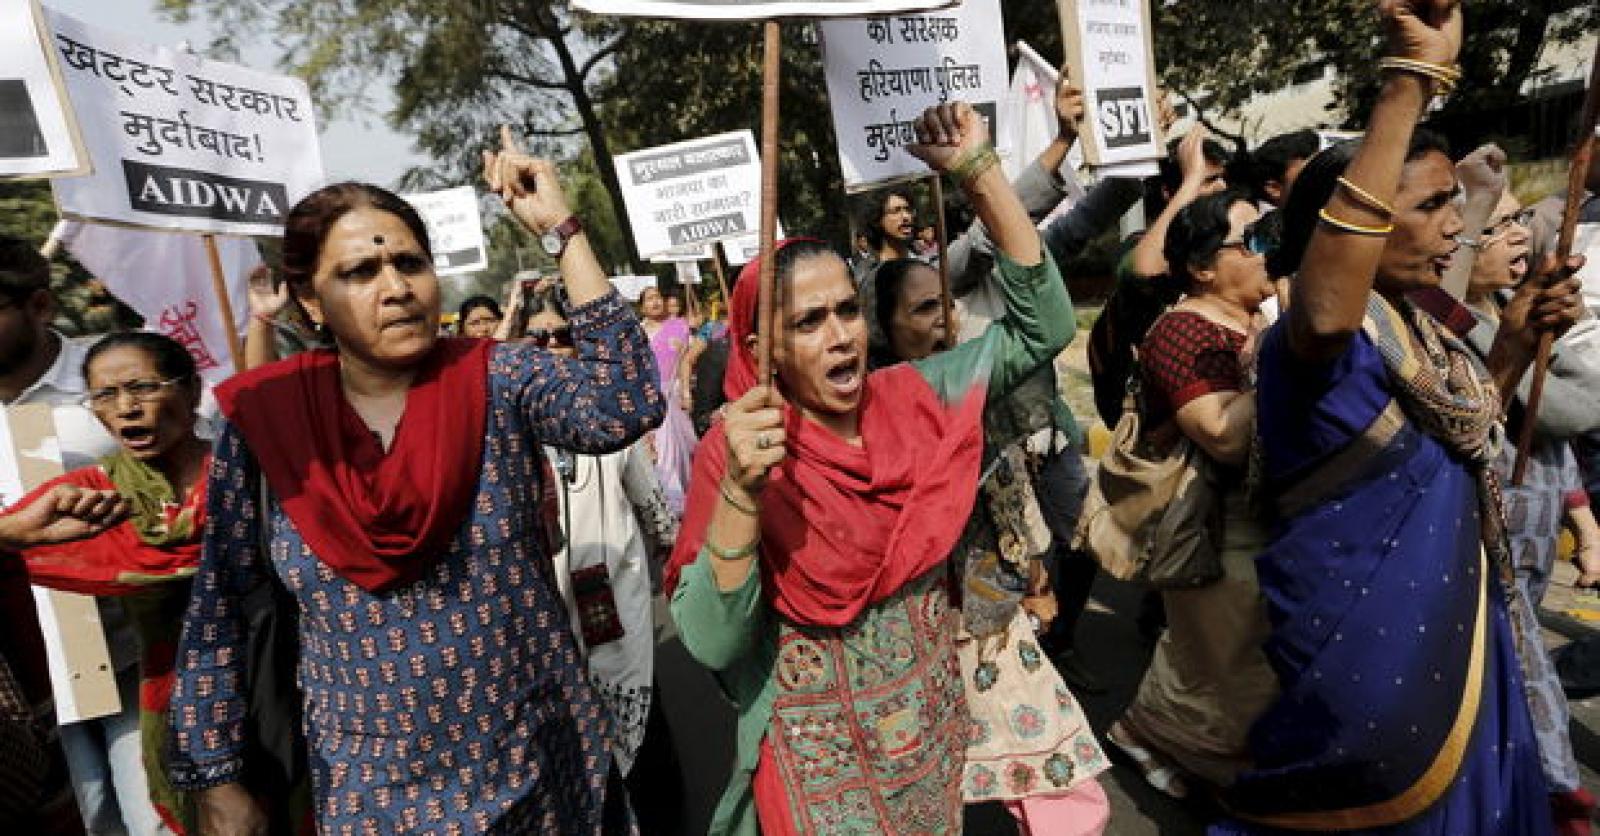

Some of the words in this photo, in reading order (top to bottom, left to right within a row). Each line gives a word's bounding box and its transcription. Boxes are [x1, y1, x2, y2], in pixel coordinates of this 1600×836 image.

[57, 34, 178, 96] खट्टर
[186, 75, 302, 121] सरकार
[858, 59, 932, 103] हरियाणा
[934, 56, 980, 103] पुलिस
[120, 110, 264, 162] मुर्दाबाद!
[140, 173, 280, 215] AIDWA
